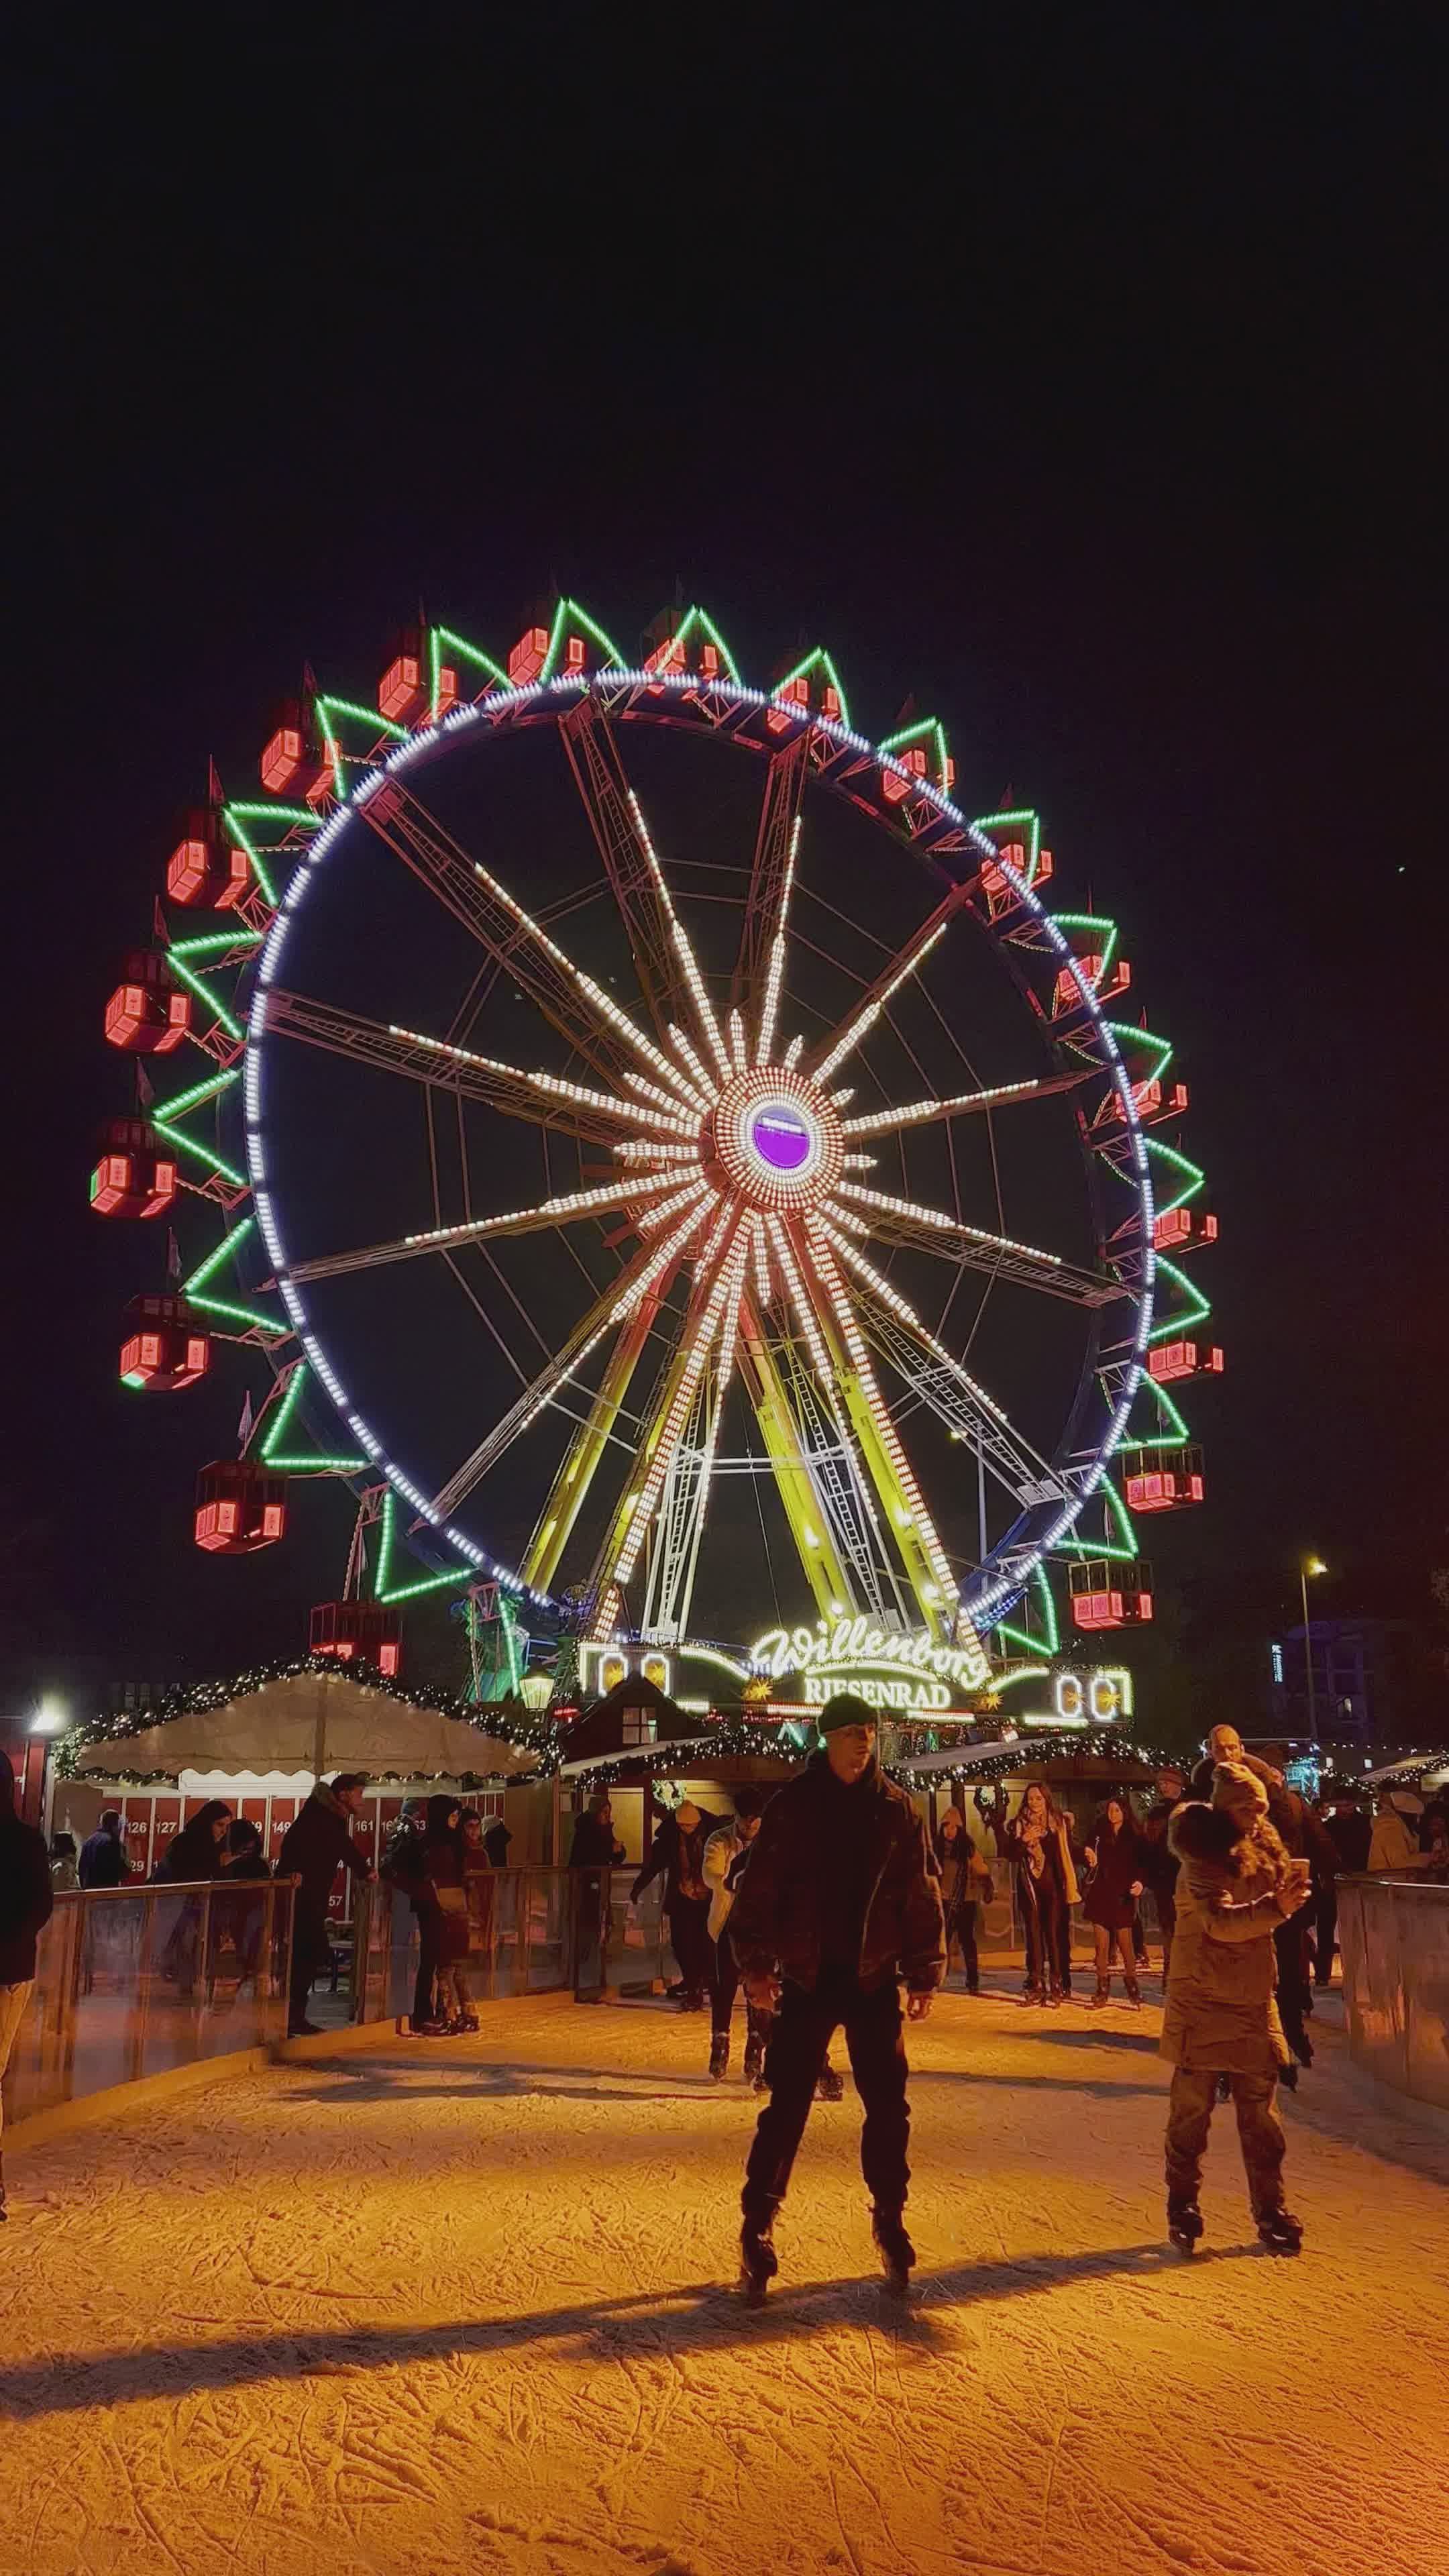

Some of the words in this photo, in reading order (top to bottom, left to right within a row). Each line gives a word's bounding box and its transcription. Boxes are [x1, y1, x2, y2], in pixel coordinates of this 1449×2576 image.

[749, 1614, 993, 1691] Willenborg
[804, 1677, 951, 1709] RIESENRAD
[127, 1821, 147, 1834] 126
[155, 1821, 178, 1835] 127
[272, 1821, 292, 1833] 149
[355, 1820, 374, 1832] 161
[380, 1820, 392, 1833] 16
[129, 1860, 145, 1872] 29
[328, 1895, 343, 1907] 57
